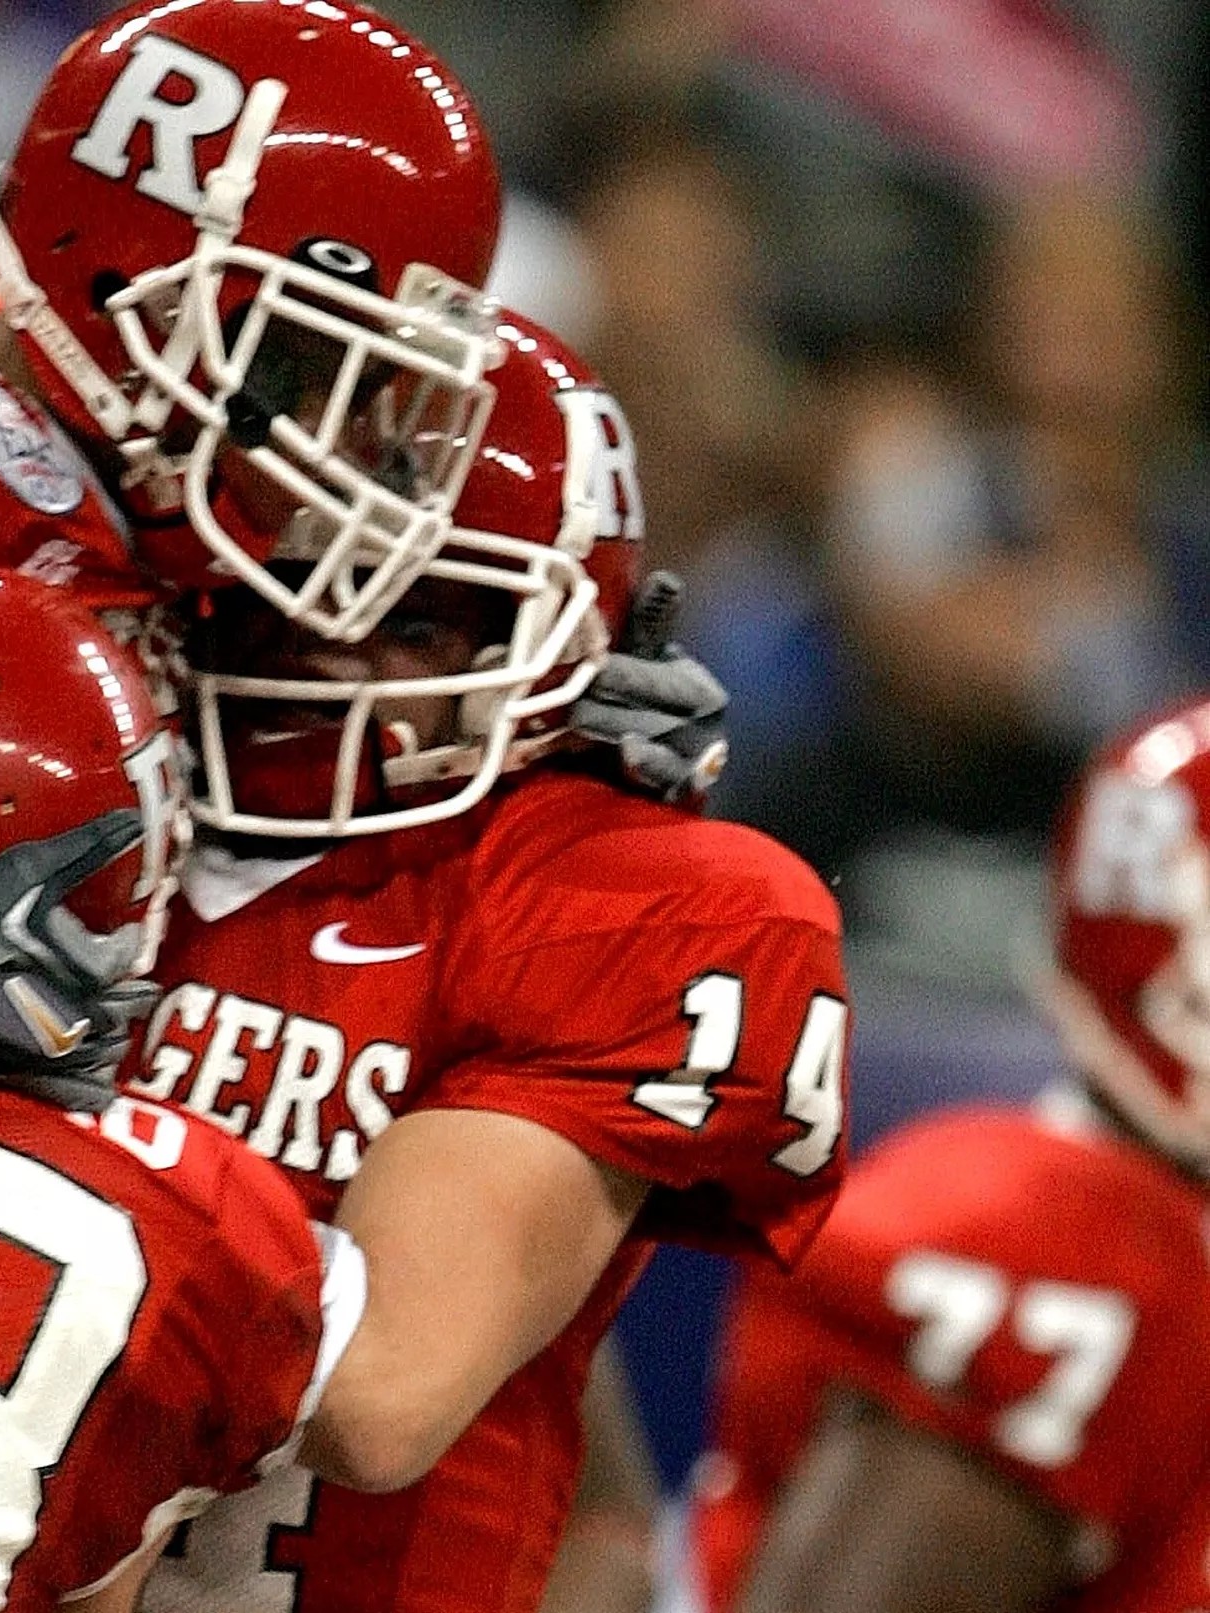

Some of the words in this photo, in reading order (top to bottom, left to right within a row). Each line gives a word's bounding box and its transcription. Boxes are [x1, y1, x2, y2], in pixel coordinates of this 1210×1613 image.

[72, 35, 246, 213] R
[632, 970, 848, 1176] 14
[886, 1248, 1136, 1468] 77
